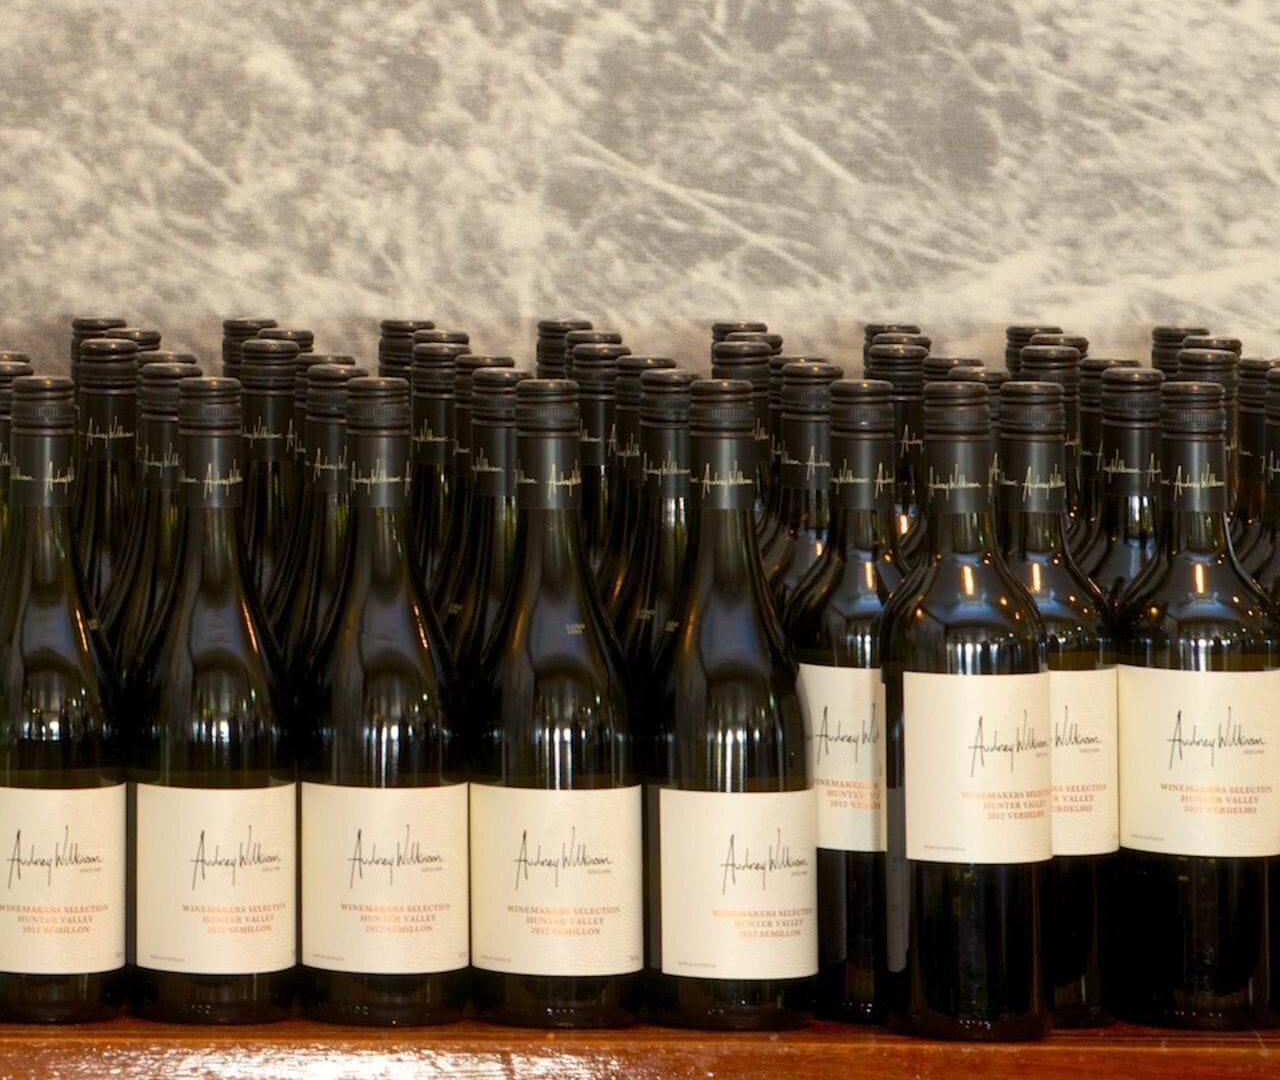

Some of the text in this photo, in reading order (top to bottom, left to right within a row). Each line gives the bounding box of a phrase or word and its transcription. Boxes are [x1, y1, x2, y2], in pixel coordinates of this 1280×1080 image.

[815, 705, 860, 765] Audrey
[968, 715, 1015, 778] Audrey
[1055, 704, 1101, 747] Wilkinson
[1166, 704, 1267, 770] Audrey Wilkinson
[6, 824, 102, 890] Audrey Wilkinson
[189, 824, 282, 890] Audrey Wilkinson
[348, 823, 443, 890] Audrey Wilkinson
[513, 825, 613, 890] Audrey Wilkinson
[719, 827, 809, 896] Audrey Wilkinson
